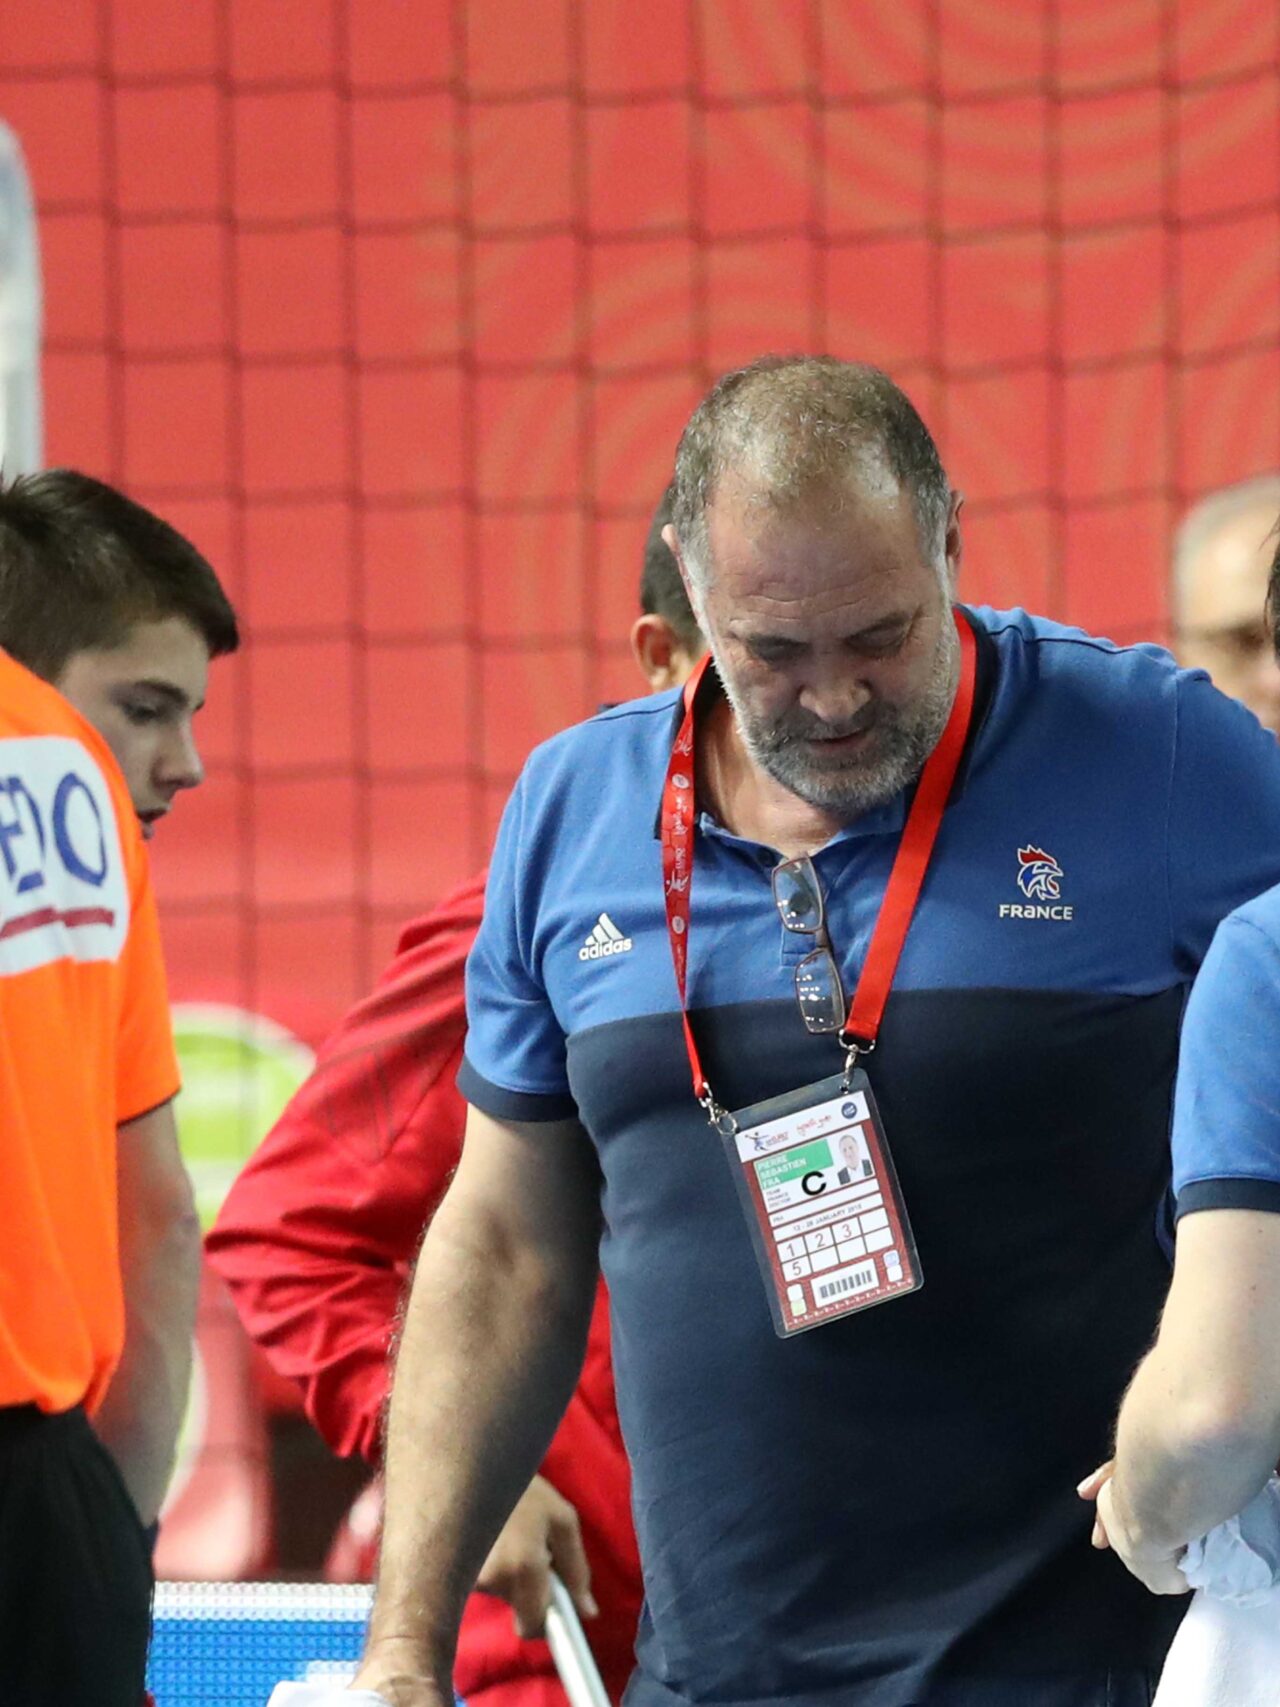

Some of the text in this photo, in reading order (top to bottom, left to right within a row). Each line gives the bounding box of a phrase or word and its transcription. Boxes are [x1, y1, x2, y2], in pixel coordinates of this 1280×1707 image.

[578, 938, 632, 960] adidas
[801, 1170, 827, 1196] C
[816, 1208, 846, 1223] JANUARY
[786, 1223, 852, 1257] 1 2 3
[792, 1262, 802, 1276] 5
